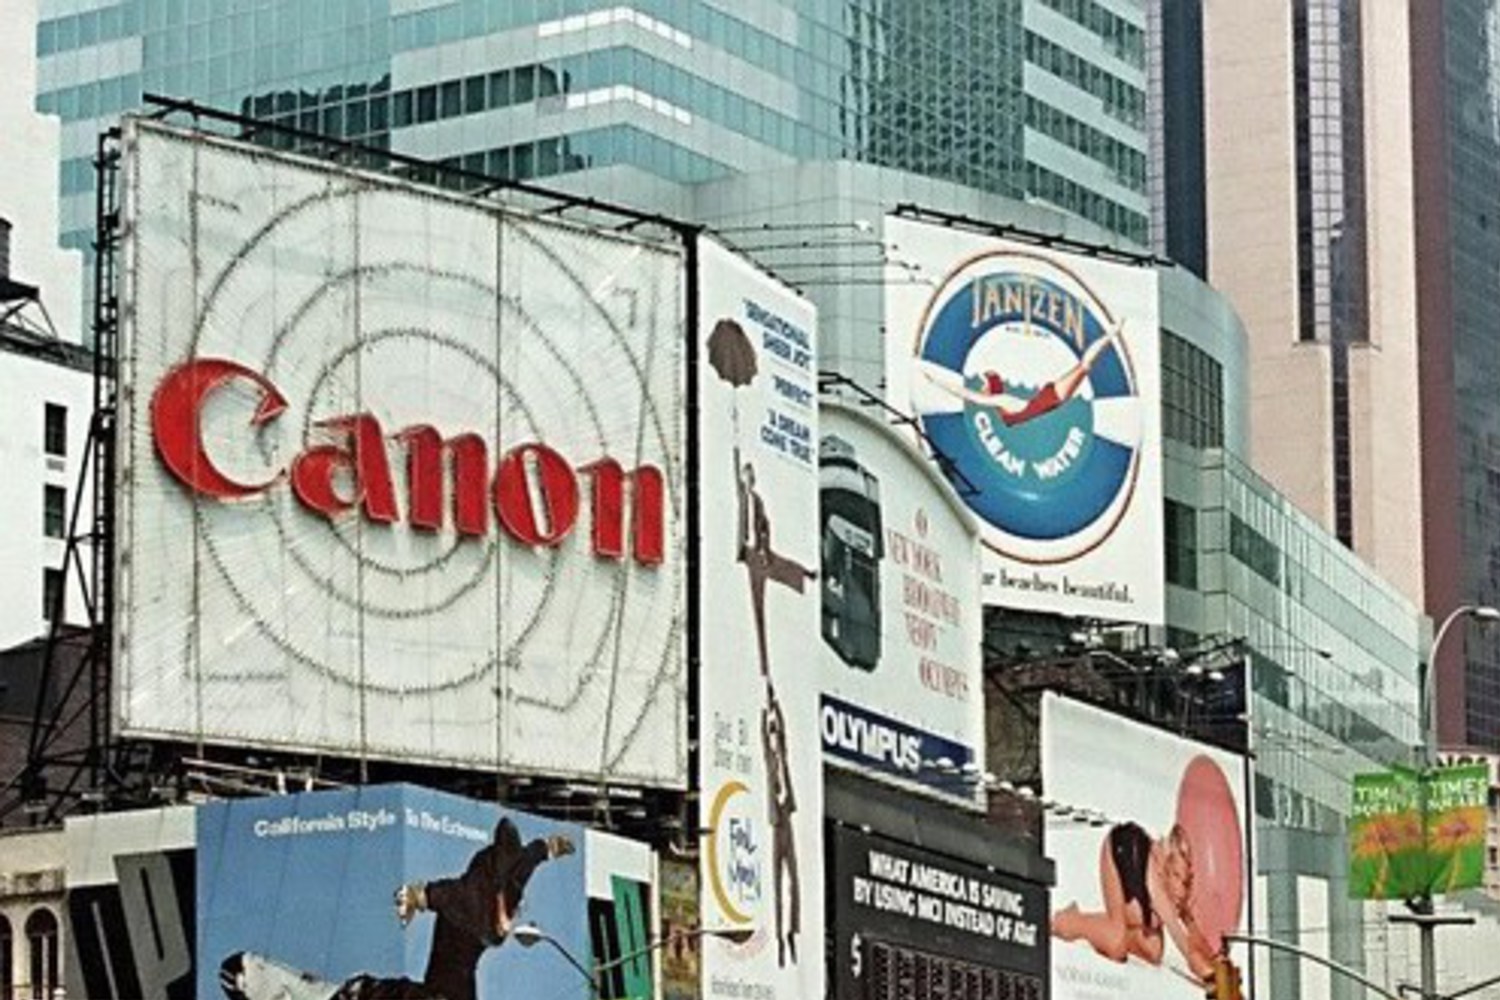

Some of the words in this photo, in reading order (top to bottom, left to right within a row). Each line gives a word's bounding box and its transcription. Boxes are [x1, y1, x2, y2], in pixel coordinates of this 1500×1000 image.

[972, 270, 1085, 350] JANTZEN
[150, 357, 665, 567] Canon
[974, 411, 1025, 477] CLEAN
[1032, 426, 1086, 478] WATER
[822, 704, 922, 774] OLYMPUS
[254, 813, 345, 838] California
[348, 808, 397, 835] Style
[853, 876, 872, 906] BY
[874, 883, 916, 917] USING
[917, 893, 943, 923] MCI
[945, 902, 994, 937] INSTEAD
[996, 915, 1013, 940] OF
[869, 849, 909, 885] WHAT
[909, 863, 967, 900] AMERICA
[969, 880, 980, 904] IS
[982, 884, 1024, 916] SAVING
